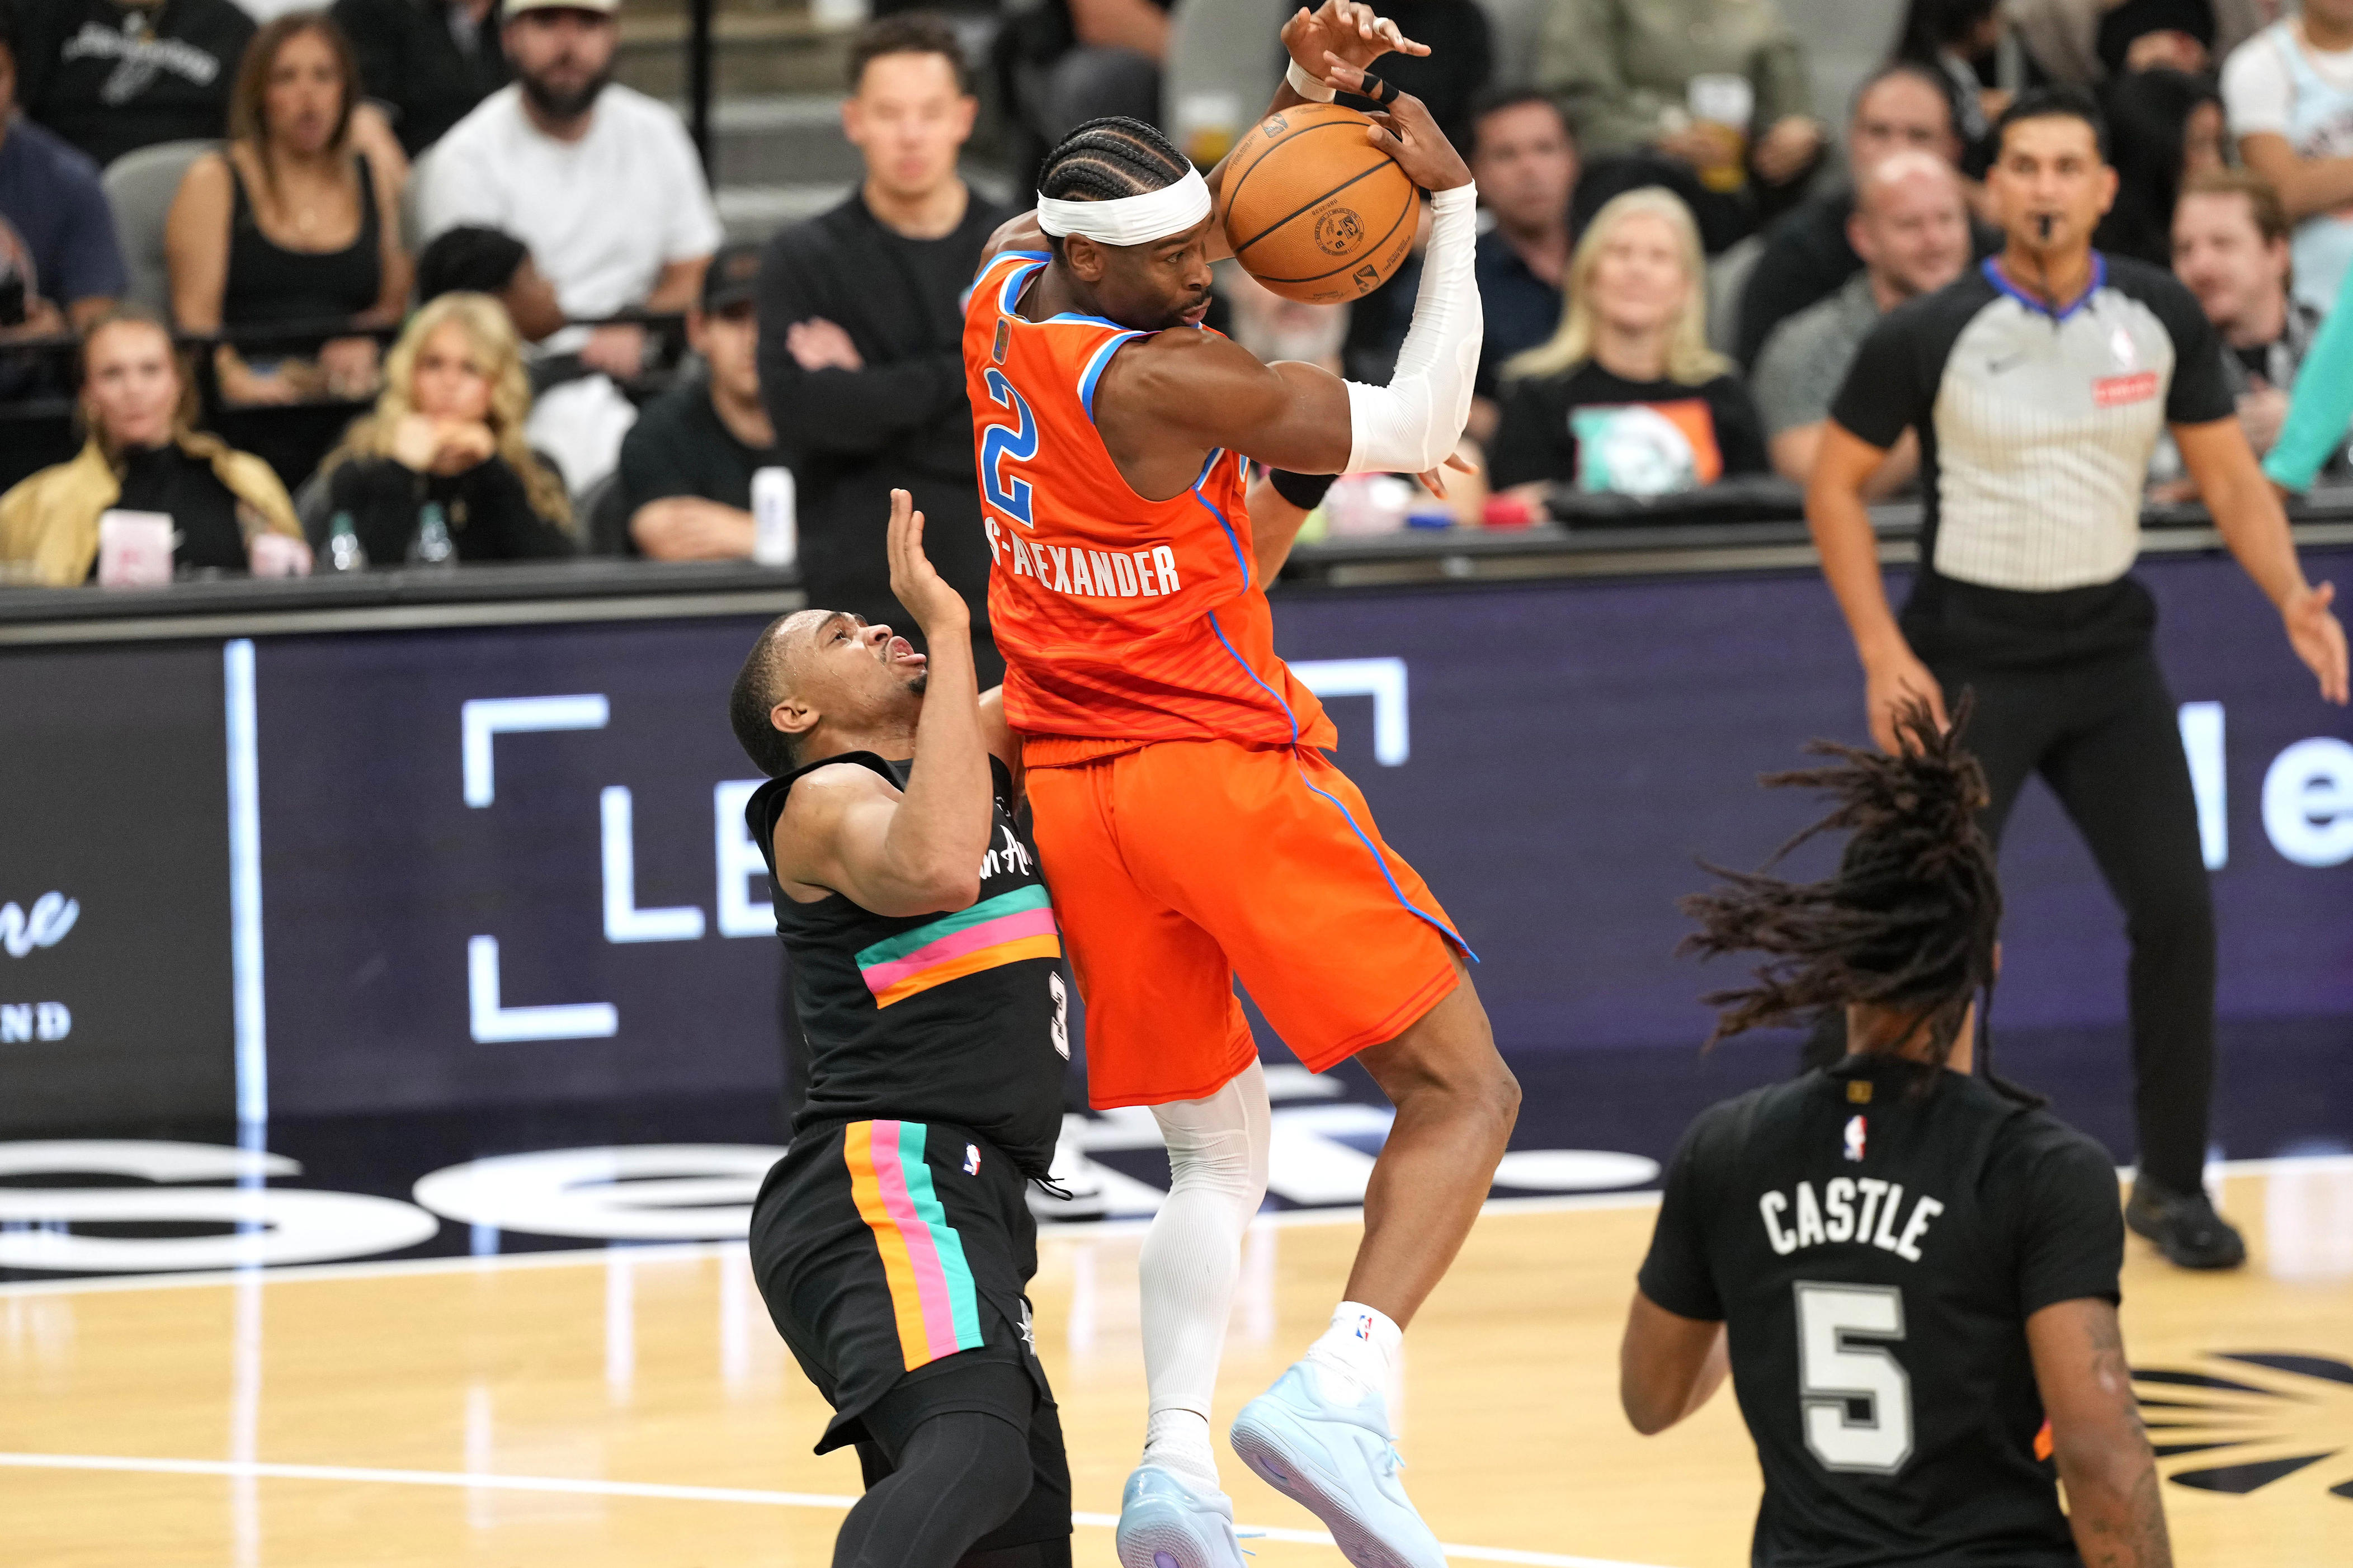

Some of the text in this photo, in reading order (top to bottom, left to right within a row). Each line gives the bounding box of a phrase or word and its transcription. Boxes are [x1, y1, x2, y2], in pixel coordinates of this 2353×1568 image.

[980, 367, 1039, 530] 2
[600, 777, 781, 944] LE
[1049, 970, 1072, 1061] 3
[1759, 1177, 1945, 1263] CASTLE
[1793, 1280, 1915, 1476] 5
